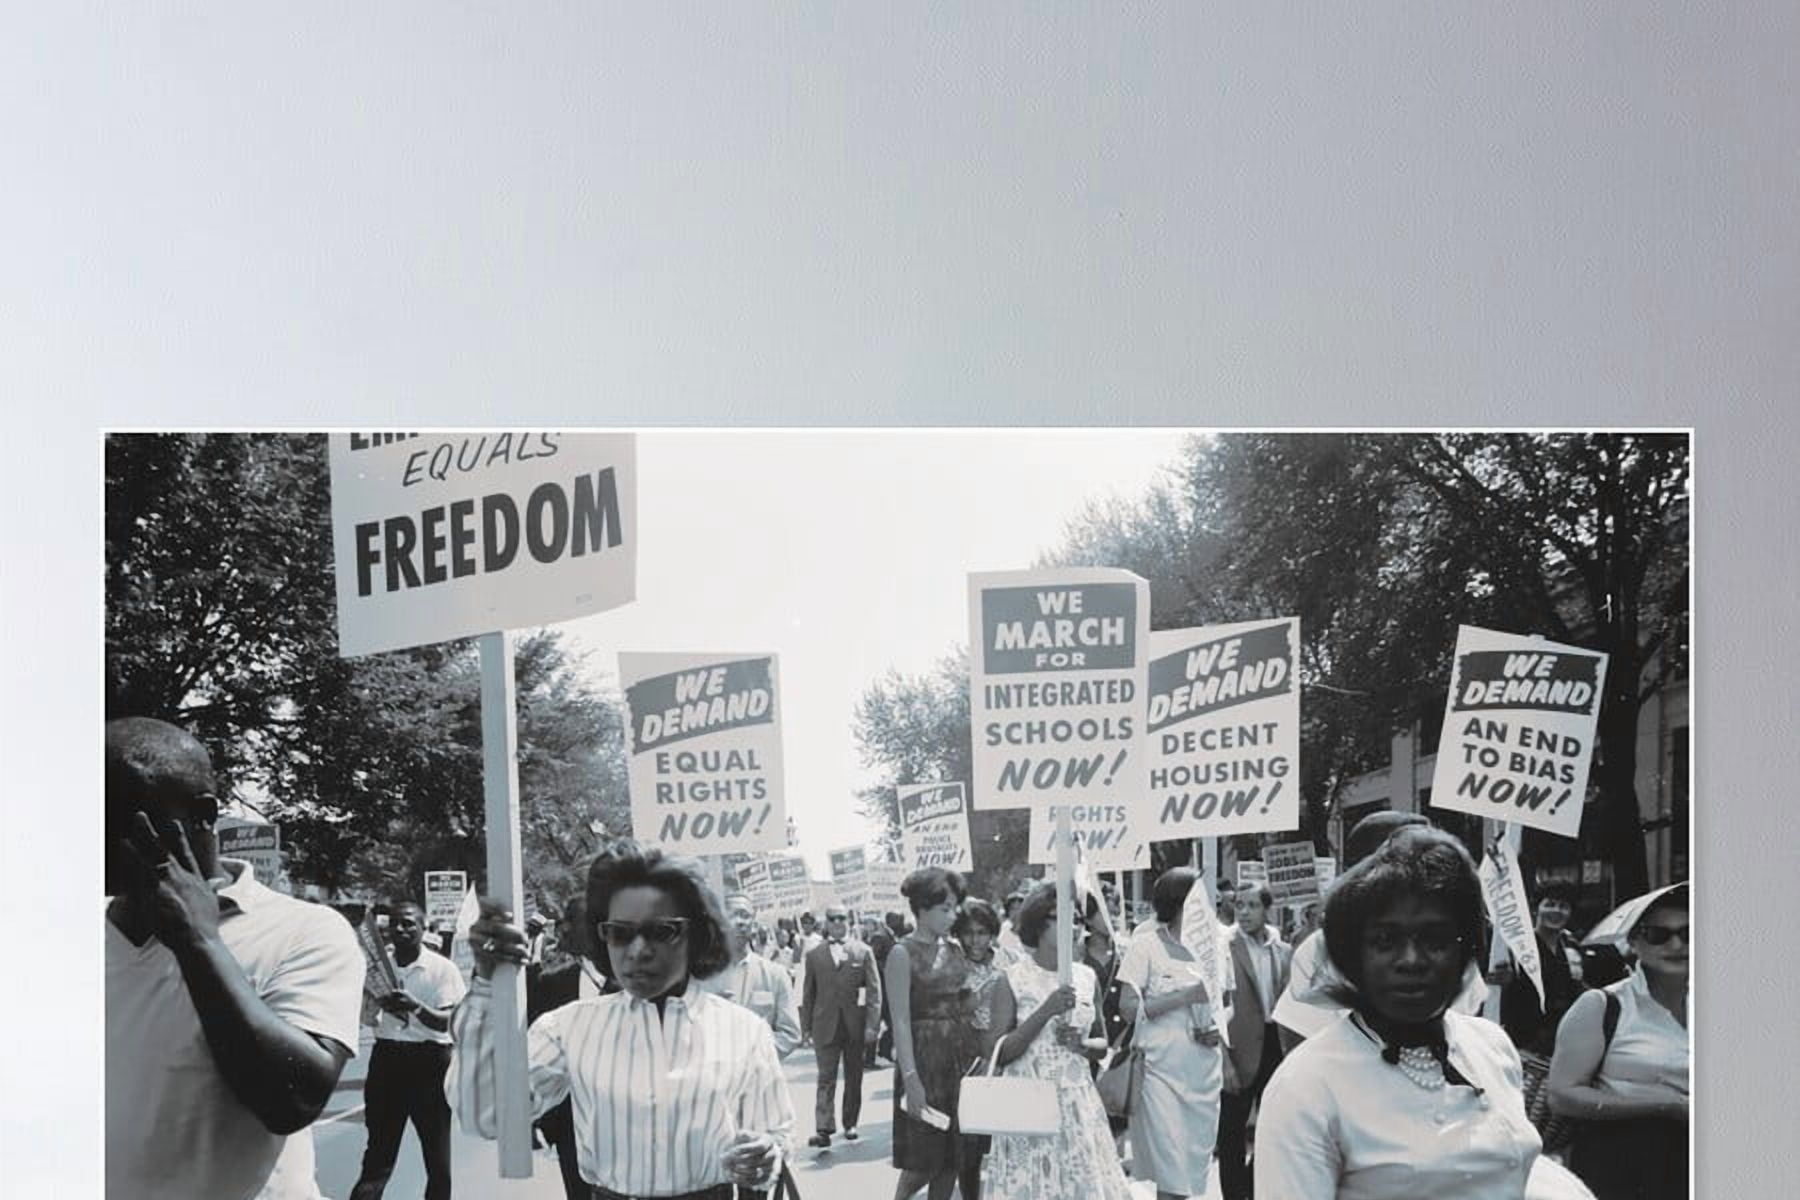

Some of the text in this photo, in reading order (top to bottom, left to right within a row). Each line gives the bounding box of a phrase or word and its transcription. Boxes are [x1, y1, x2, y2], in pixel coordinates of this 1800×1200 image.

[402, 433, 560, 487] EQUALS
[355, 466, 622, 597] FREEDOM
[1037, 590, 1082, 615] WE
[995, 617, 1125, 650] MARCH
[1035, 652, 1087, 668] FOR
[1186, 639, 1242, 680] WE
[1503, 654, 1558, 678] WE
[675, 667, 727, 703] WE
[985, 678, 1135, 710] INTEGRATED
[1149, 657, 1287, 725] DEMAND
[1462, 680, 1592, 706] DEMAND
[640, 688, 769, 743] DEMAND
[986, 717, 1133, 746] SCHOOLS
[1162, 722, 1279, 755] DECENT
[1463, 717, 1582, 758] AN END
[656, 749, 762, 775] EQUAL
[997, 749, 1128, 792] NOW!
[1150, 757, 1290, 790] HOUSING
[1462, 743, 1575, 784] TO BIAS
[656, 777, 767, 804] RIGHTS
[1160, 781, 1283, 825] NOW!
[1457, 772, 1572, 815] NOW!
[659, 803, 772, 842] NOW!
[1048, 805, 1126, 822] RGHTS
